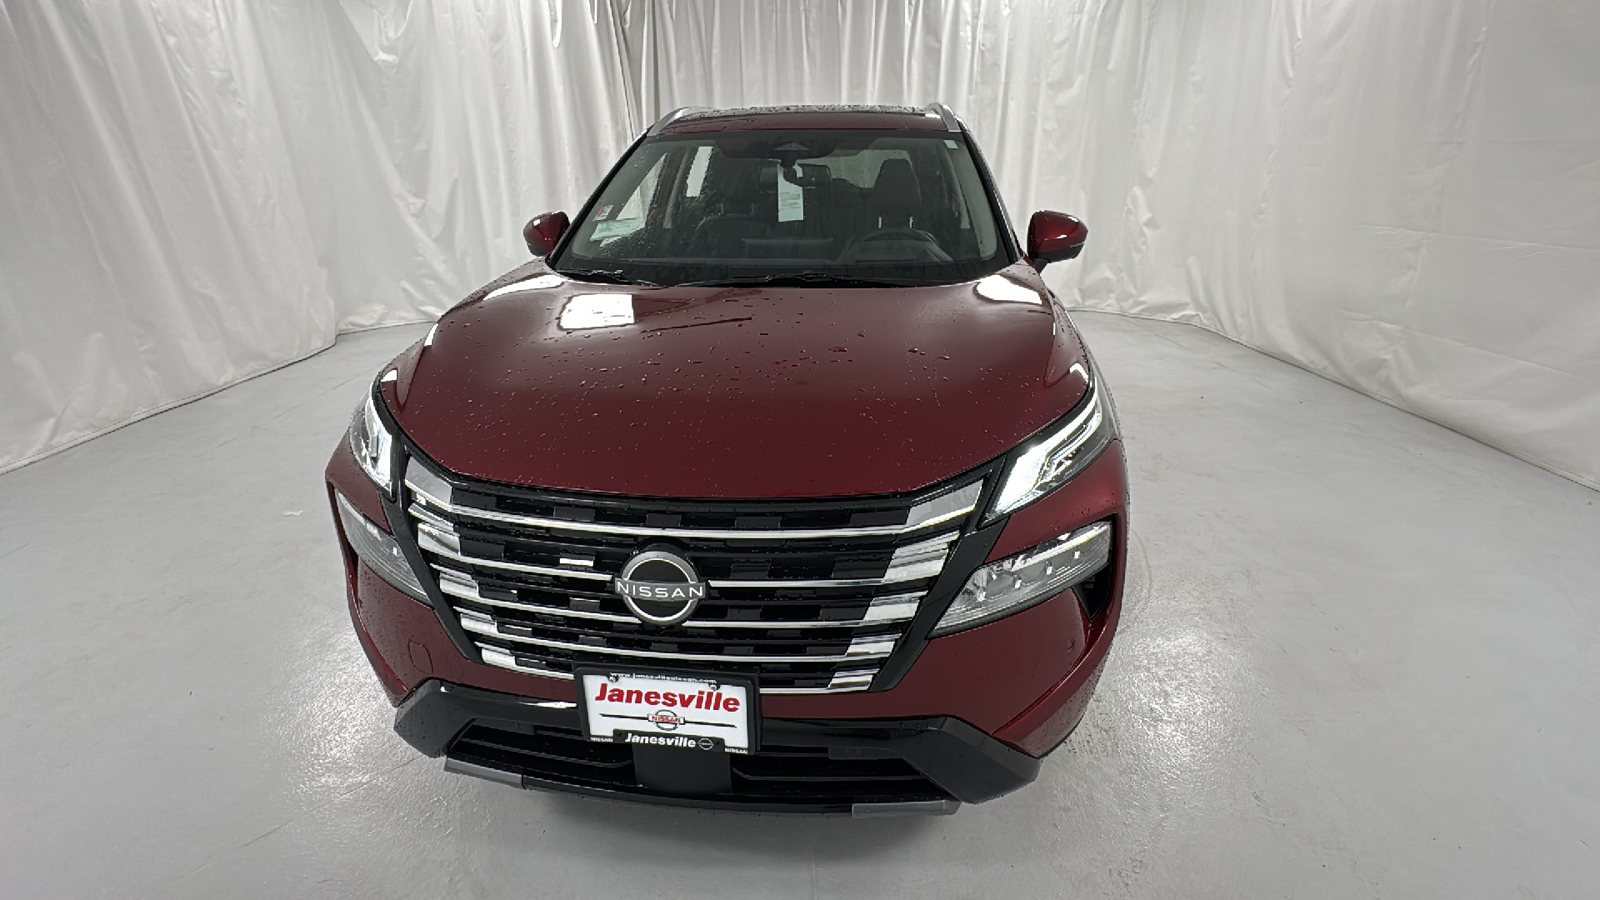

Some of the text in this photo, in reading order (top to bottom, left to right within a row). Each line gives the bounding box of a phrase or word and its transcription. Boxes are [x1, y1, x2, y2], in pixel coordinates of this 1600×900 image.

[617, 581, 703, 598] NISSAN
[595, 683, 740, 712] Janesville
[652, 715, 681, 724] NISSAN
[625, 733, 697, 748] Janesville
